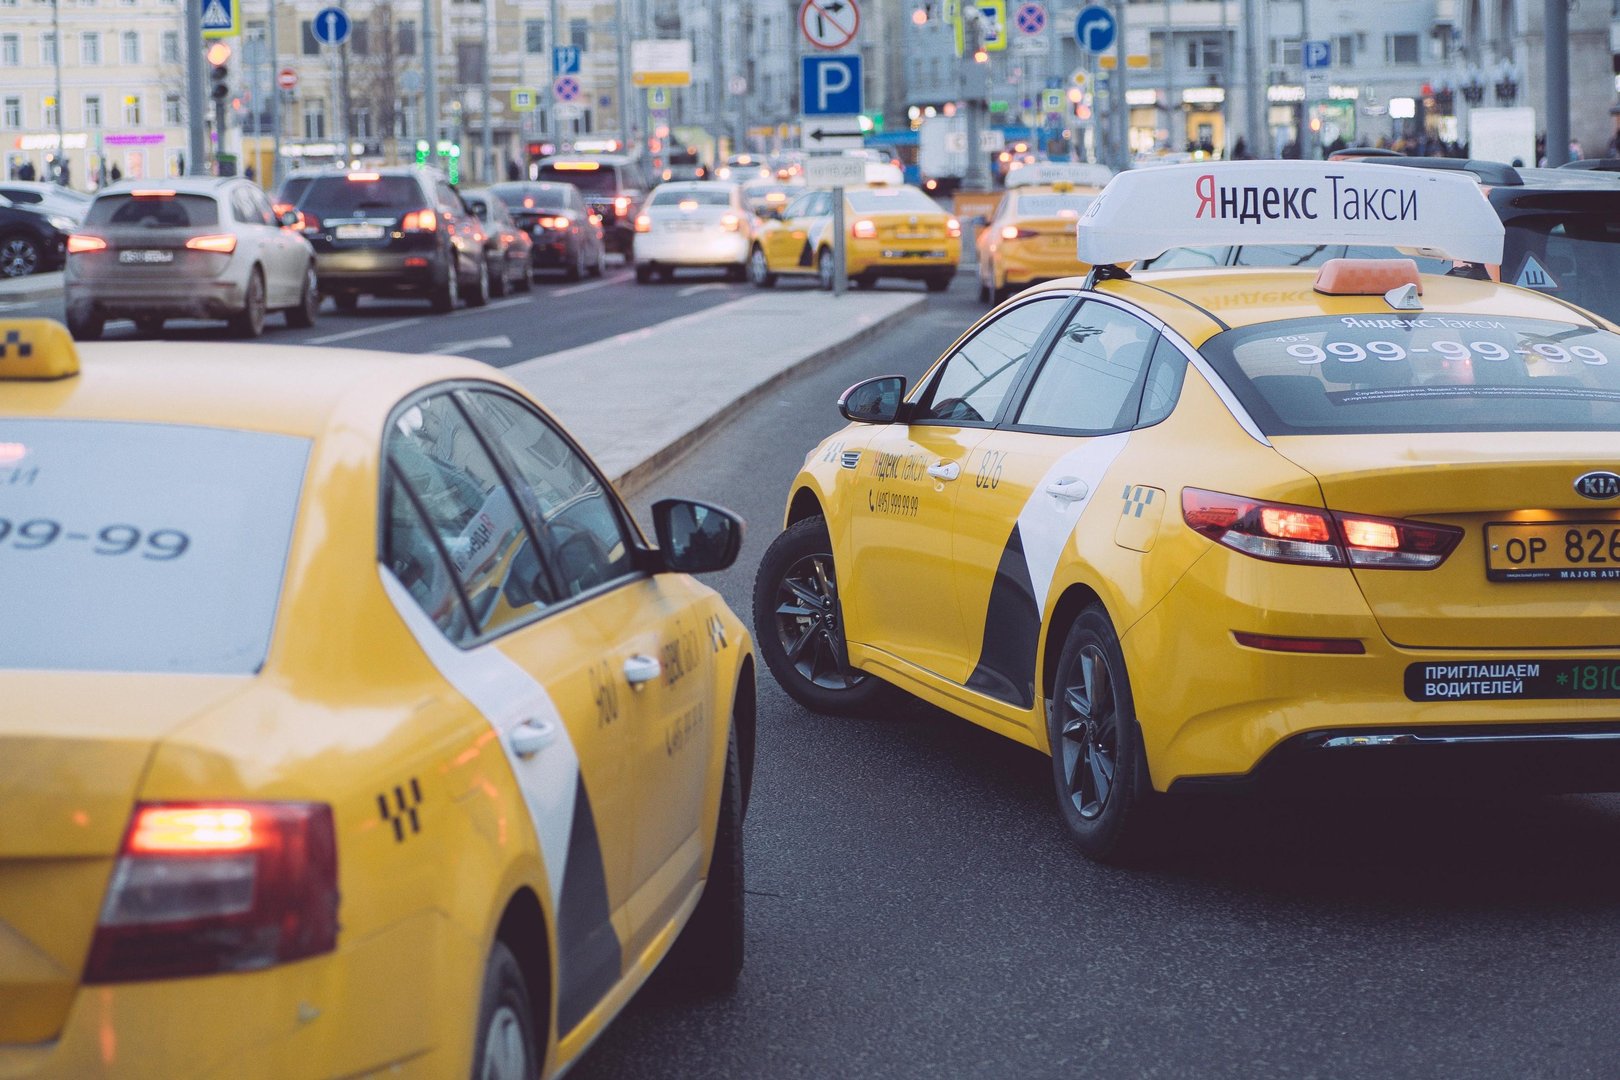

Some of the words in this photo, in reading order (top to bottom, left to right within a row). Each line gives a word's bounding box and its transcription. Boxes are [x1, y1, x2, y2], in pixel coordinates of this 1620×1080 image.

[817, 61, 852, 111] P
[1195, 175, 1318, 225] Яндекс
[1325, 175, 1418, 221] Такси
[1340, 317, 1434, 330] Яндекс
[1431, 318, 1507, 330] Такси
[1275, 335, 1309, 343] 495
[1286, 340, 1608, 366] 999-99-99
[976, 450, 1008, 489] 826
[1584, 477, 1619, 494] KIA
[0, 517, 191, 562] 9-99
[1561, 570, 1597, 578] MAJOR
[1425, 664, 1540, 679] ПРИГЛАШАЕМ
[1425, 678, 1524, 697] ВОДИТЕЛЕЙ
